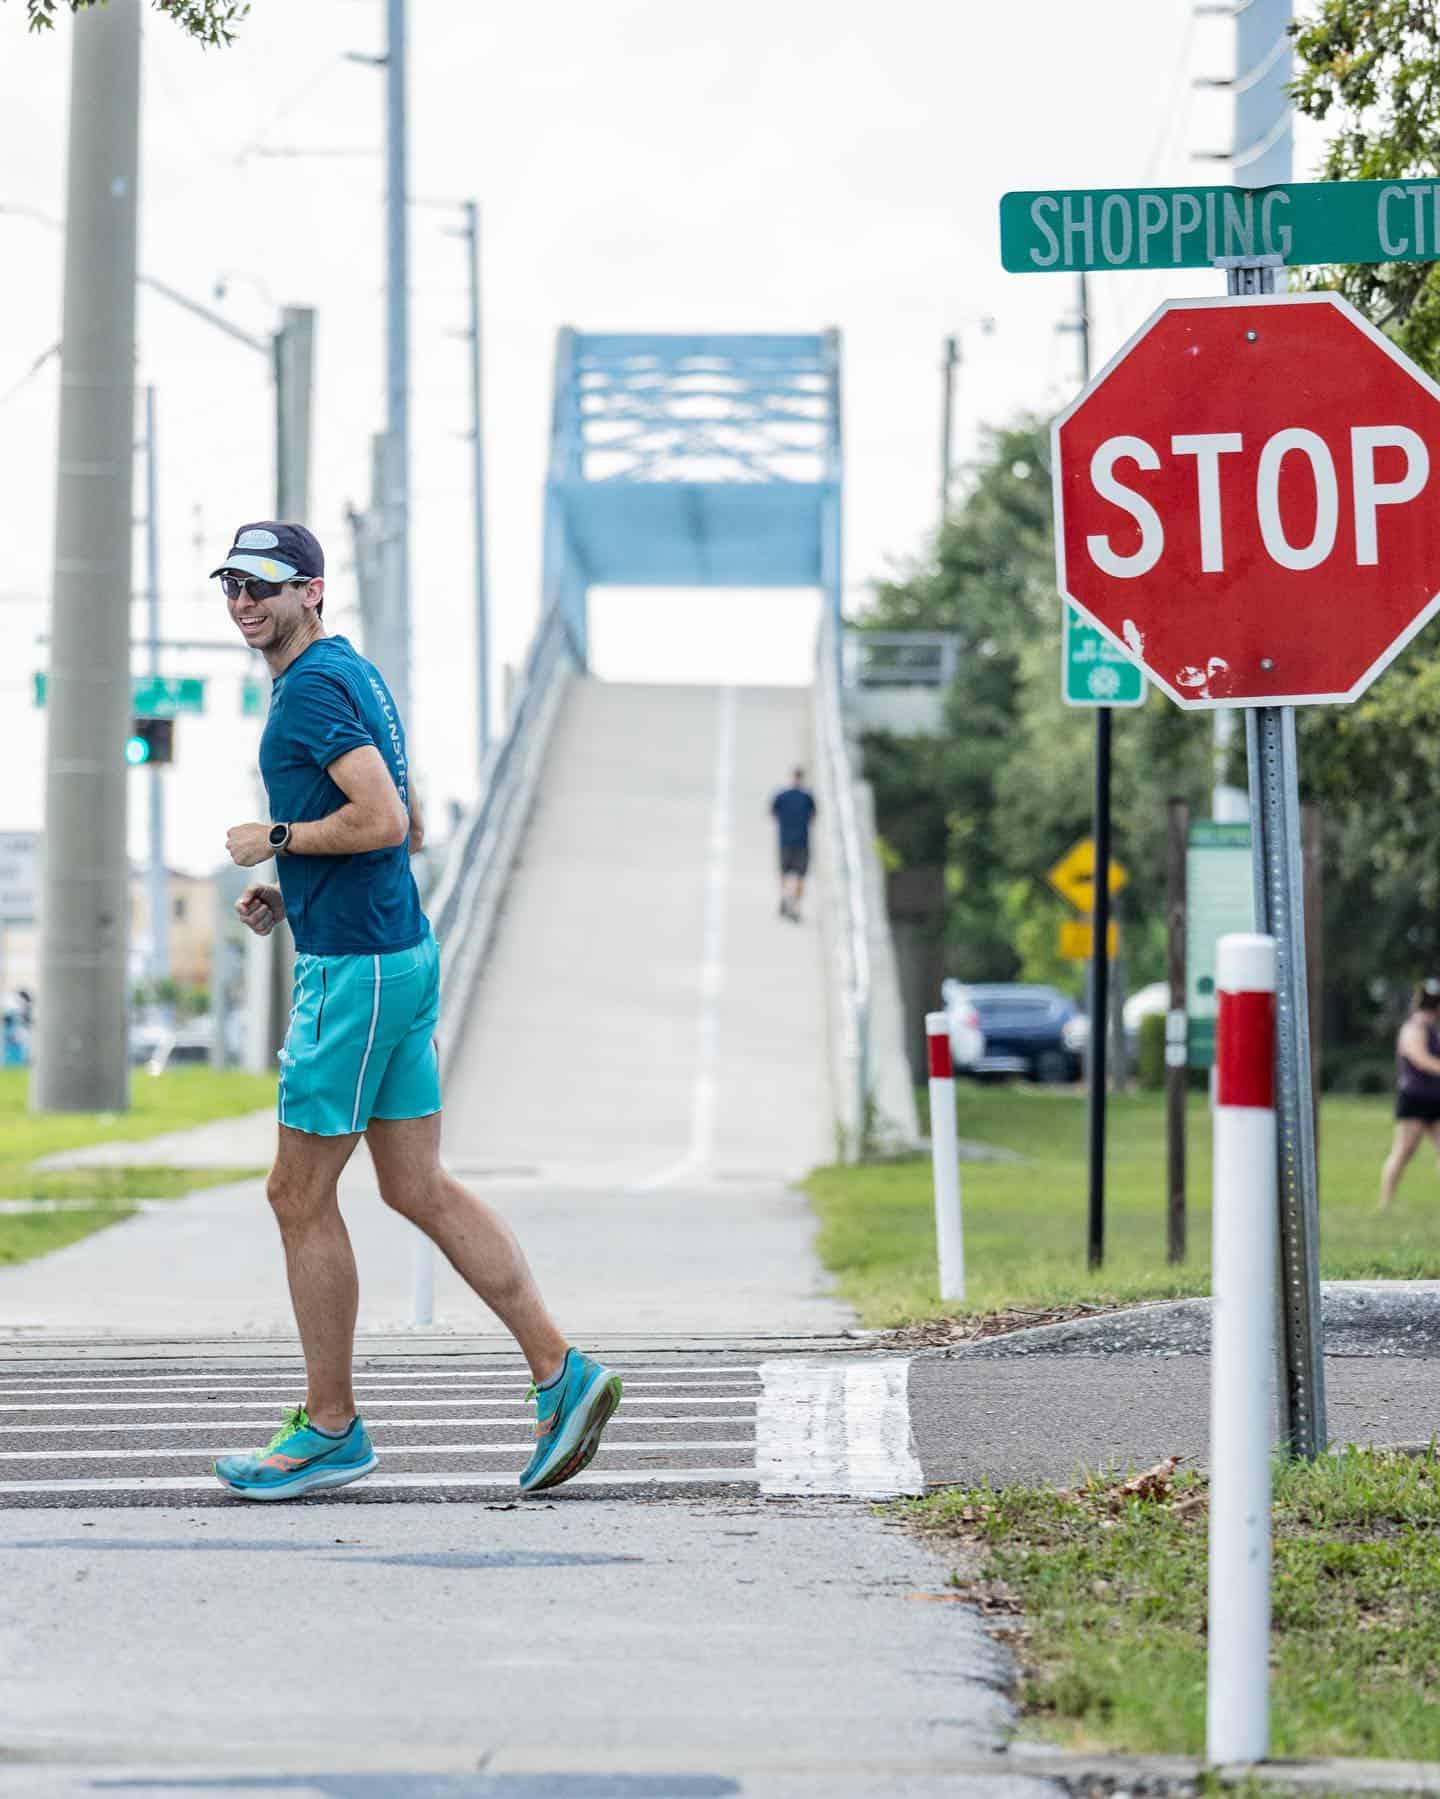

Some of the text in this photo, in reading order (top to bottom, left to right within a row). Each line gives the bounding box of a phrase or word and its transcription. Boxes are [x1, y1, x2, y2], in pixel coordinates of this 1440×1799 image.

[1029, 184, 1440, 267] SHOPPING CT
[1086, 424, 1430, 579] STOP
